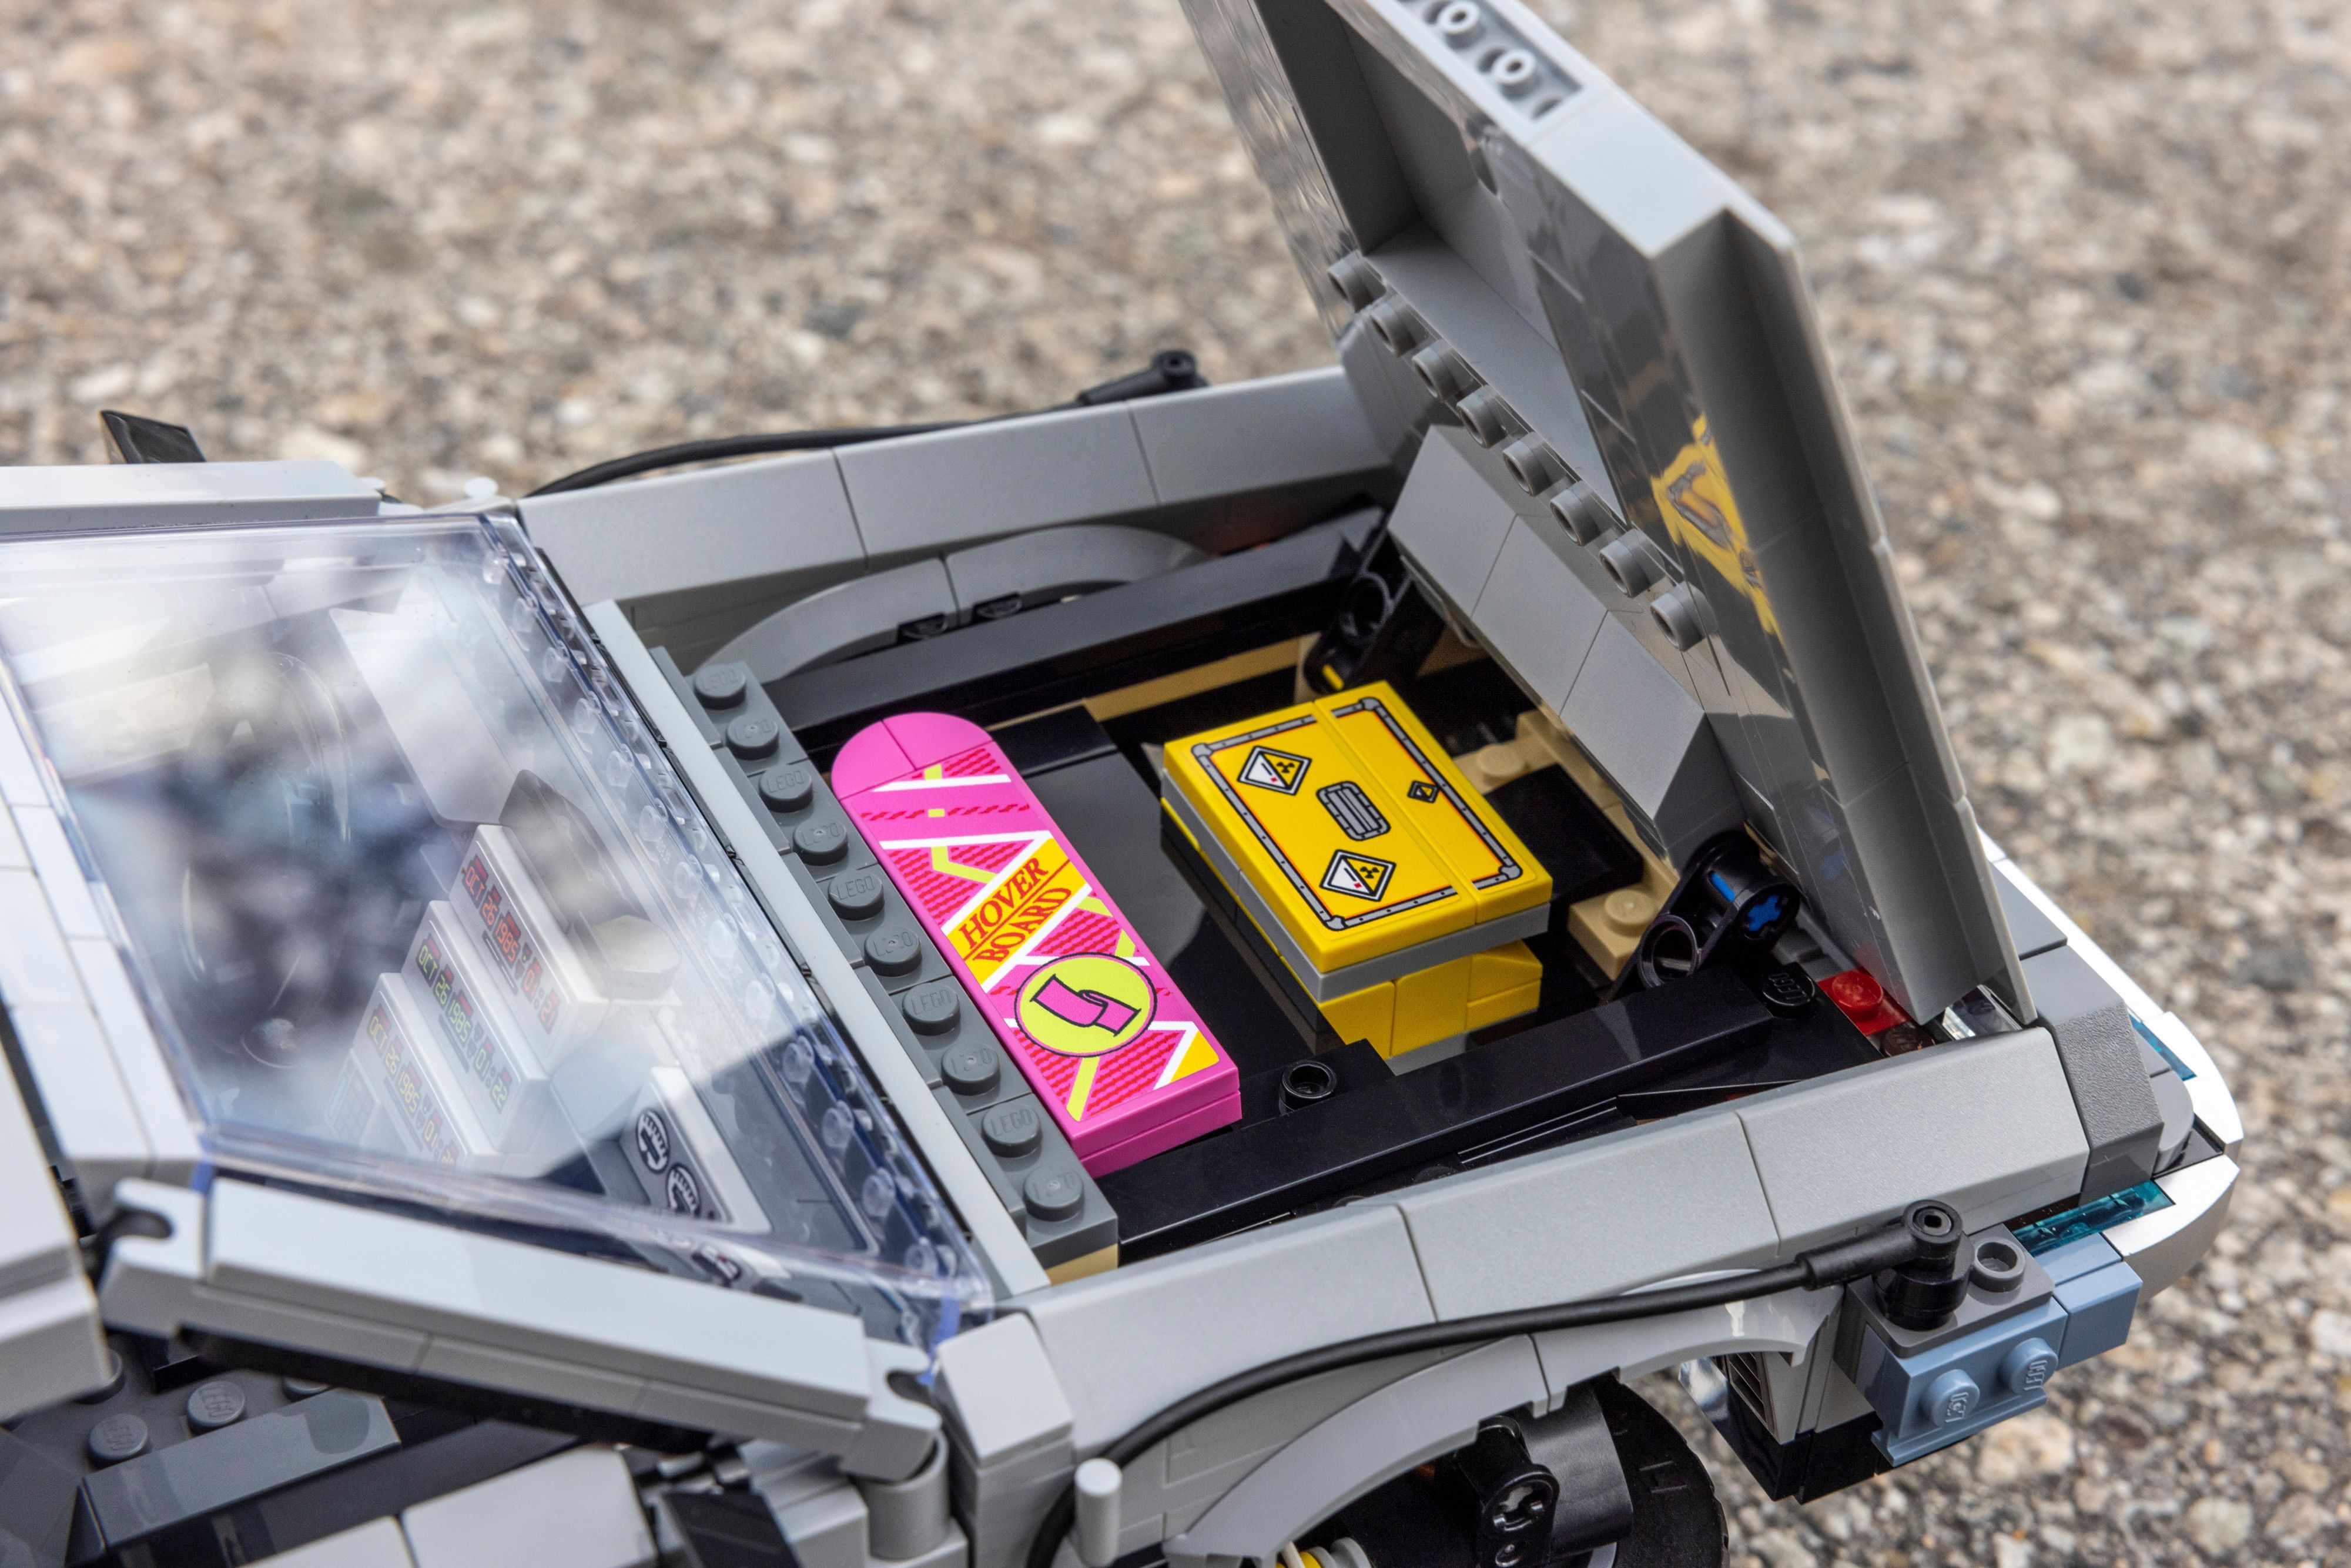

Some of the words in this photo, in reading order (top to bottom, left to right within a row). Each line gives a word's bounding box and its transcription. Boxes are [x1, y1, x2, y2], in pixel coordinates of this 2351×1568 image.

[766, 770, 804, 793] LEGO
[465, 866, 485, 900] OCT
[481, 894, 498, 927] 26
[495, 919, 520, 963] 1985
[836, 875, 876, 900] LEGO
[959, 857, 1049, 950] HOVER
[973, 887, 1071, 963] BOARD
[418, 944, 438, 980] OCT
[434, 974, 451, 1006] 26
[448, 999, 473, 1043] 1985
[910, 989, 952, 1016] LEGO
[370, 1015, 389, 1051] OCT
[397, 1070, 420, 1113] 1985
[990, 1108, 1033, 1137] LEGO
